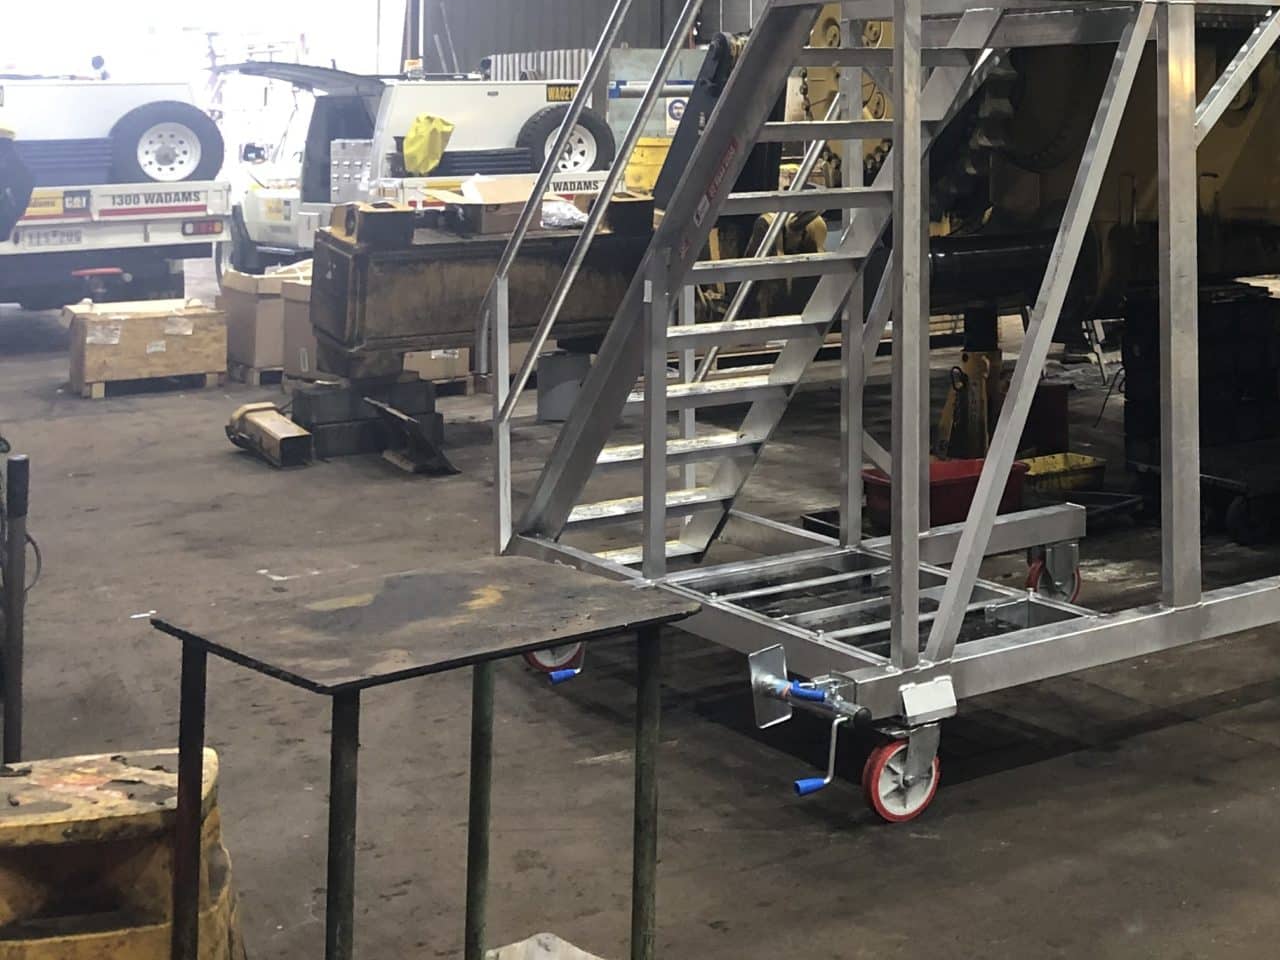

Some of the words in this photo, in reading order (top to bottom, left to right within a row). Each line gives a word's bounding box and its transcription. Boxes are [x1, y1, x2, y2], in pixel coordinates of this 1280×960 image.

[552, 180, 599, 192] WADAMS
[112, 193, 141, 206] 1300
[143, 191, 201, 205] WADAMS
